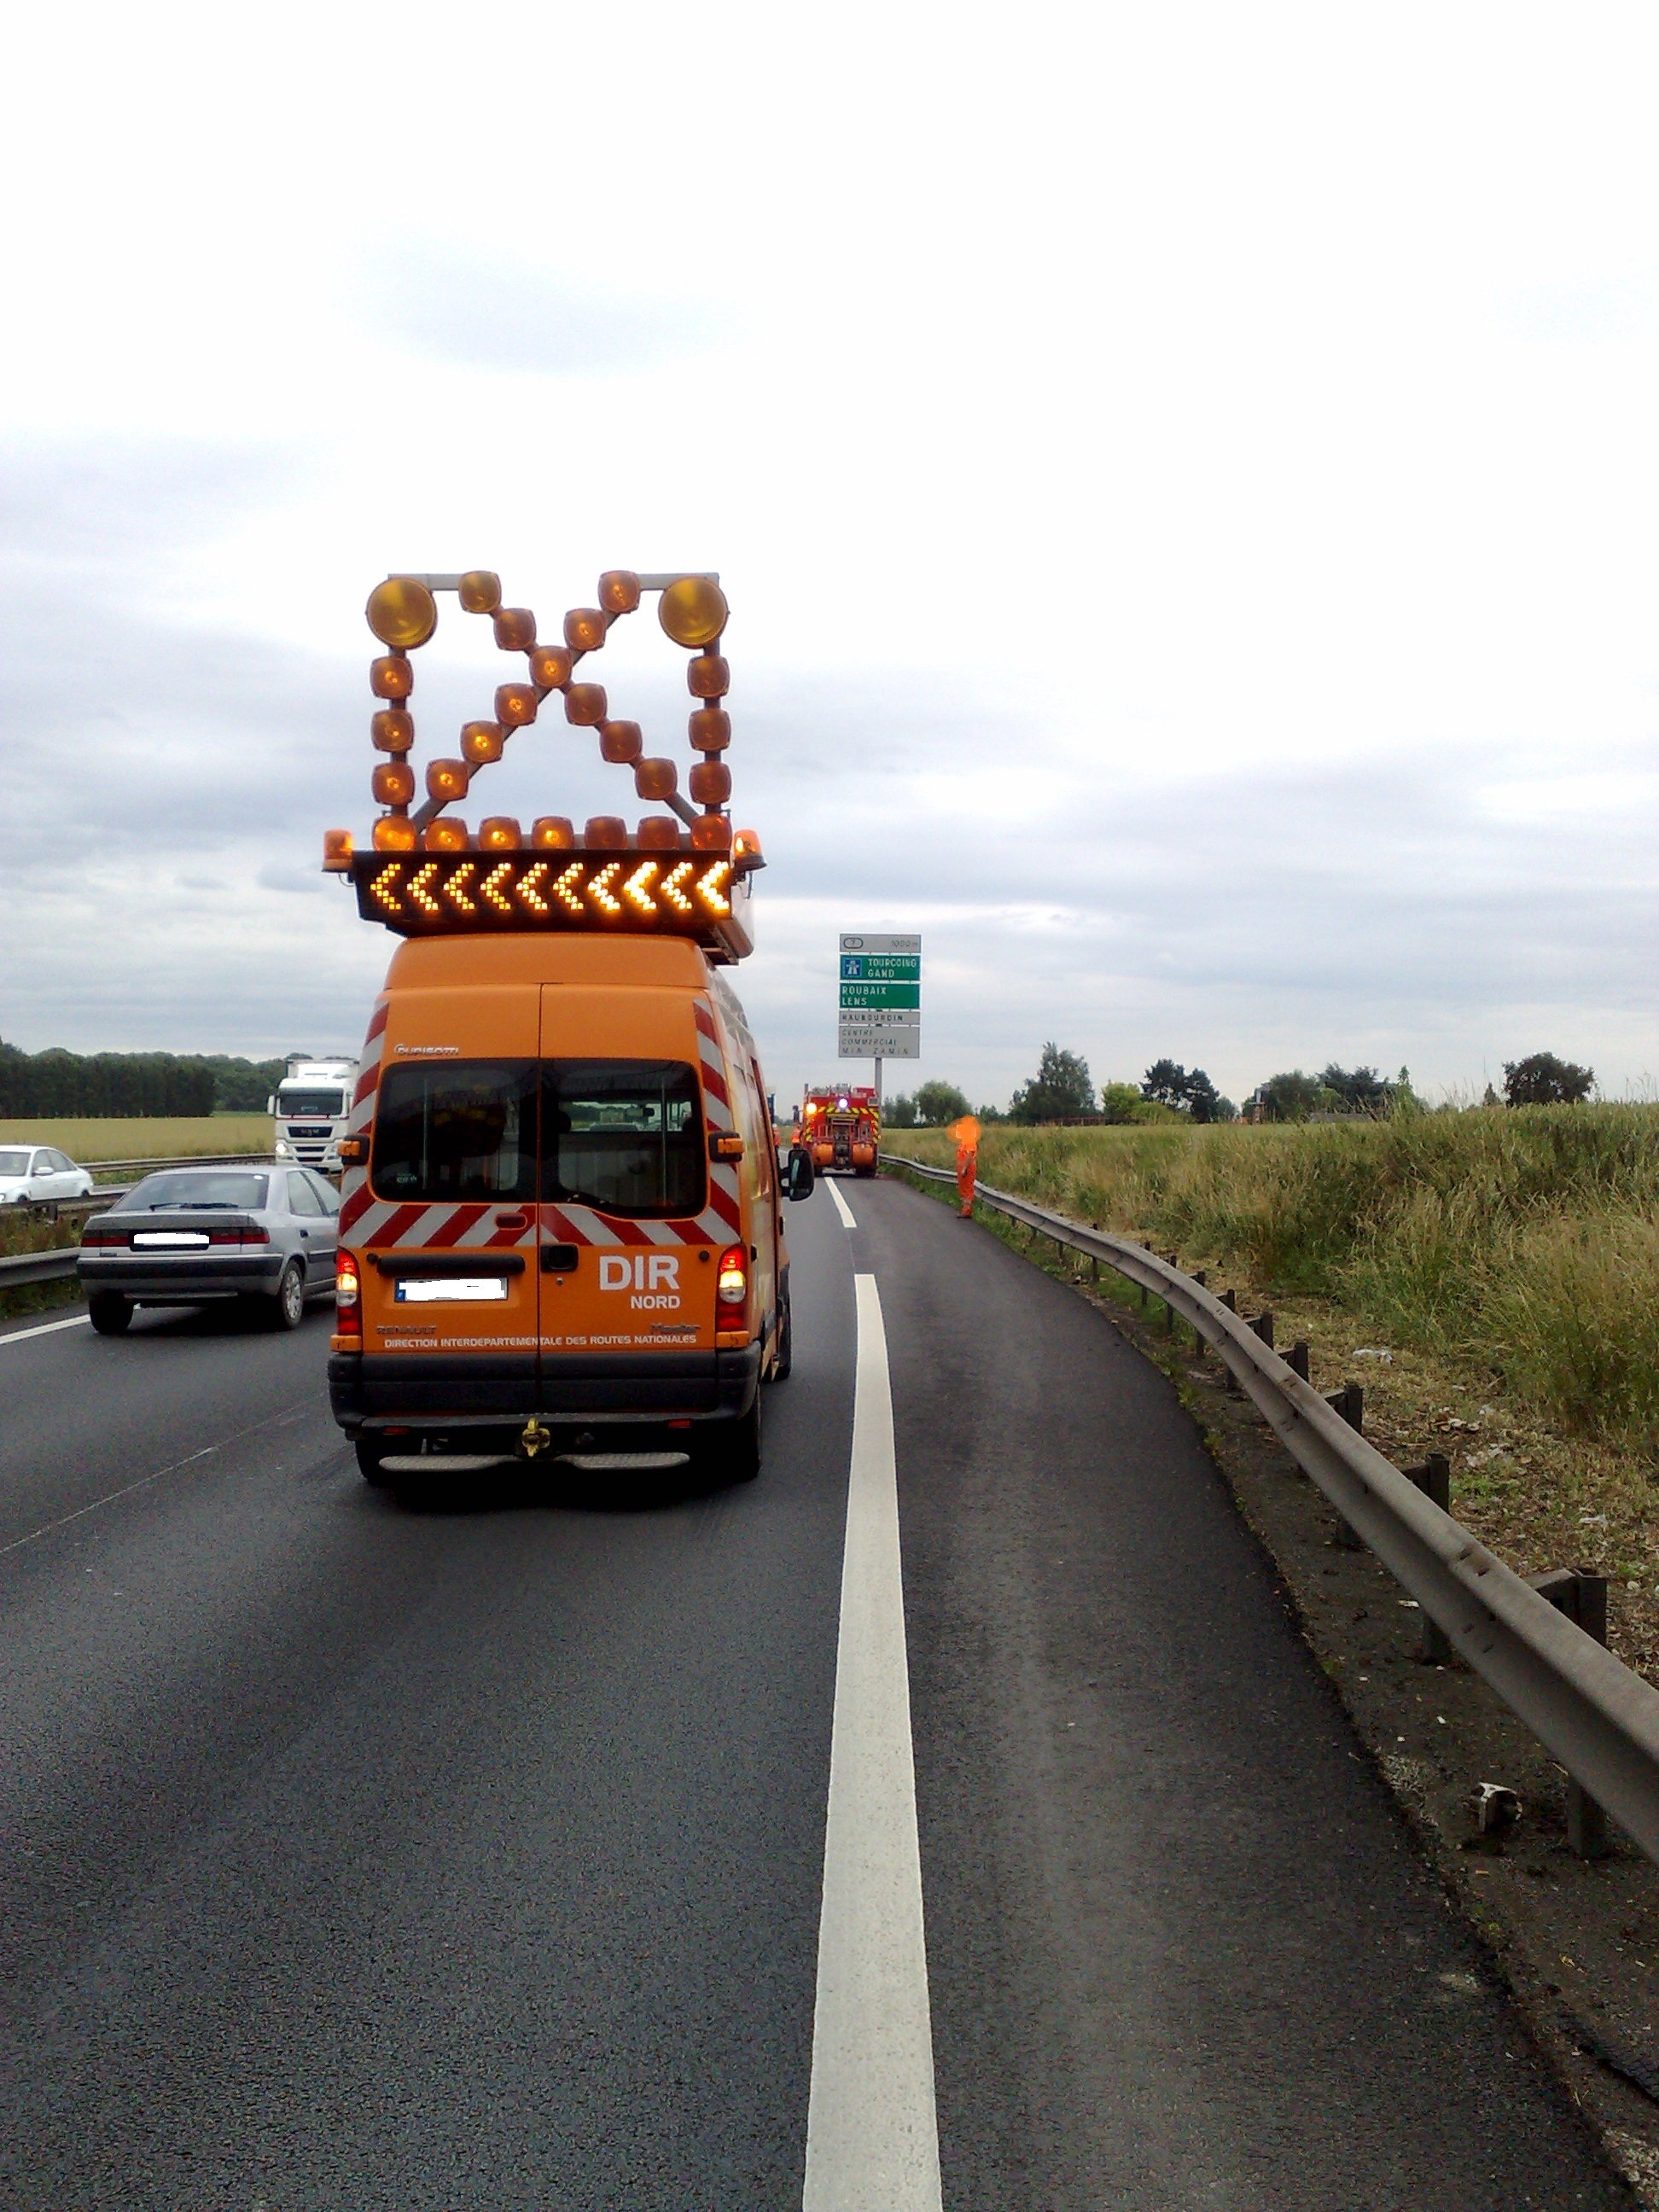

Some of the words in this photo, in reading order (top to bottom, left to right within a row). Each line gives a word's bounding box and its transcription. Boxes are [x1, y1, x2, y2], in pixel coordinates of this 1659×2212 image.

[868, 958, 917, 967] TOURCOING
[867, 969, 895, 978] GAND
[841, 986, 887, 995] ROUBAIX
[841, 997, 867, 1006] LENS
[599, 1254, 680, 1291] DIR
[631, 1295, 681, 1309] NORD
[376, 1325, 437, 1335] RENAULT
[384, 1338, 438, 1348] DIRECTION
[440, 1336, 562, 1348] INTERDEPARTEMENTALE
[566, 1336, 587, 1345] DES
[590, 1336, 632, 1345] ROUTES
[634, 1335, 696, 1344] NATIONALES
